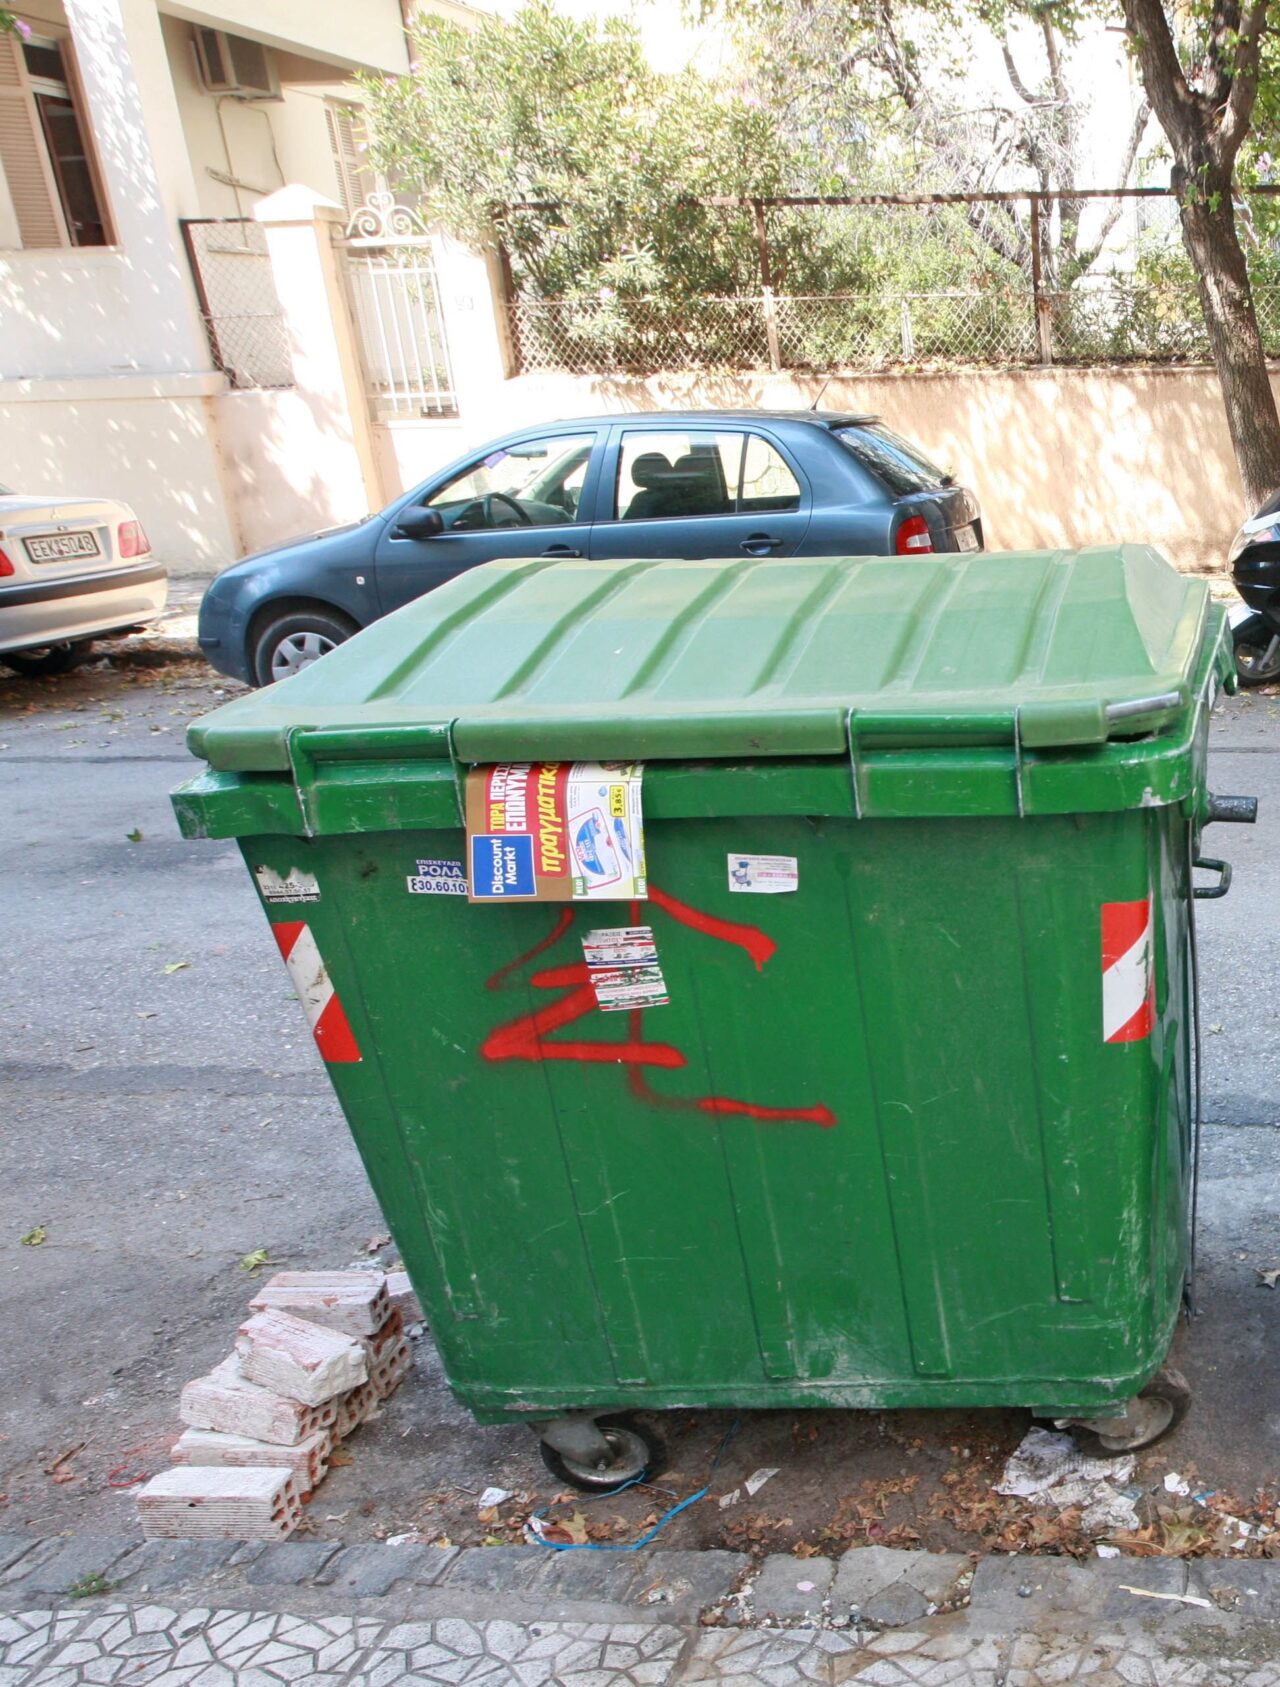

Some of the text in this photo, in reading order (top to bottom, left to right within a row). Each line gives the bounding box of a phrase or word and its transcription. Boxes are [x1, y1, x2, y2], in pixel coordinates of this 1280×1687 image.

[490, 802, 505, 831] ΤΩΡΑ
[418, 865, 463, 877] ΡΟΛΑ
[490, 838, 504, 894] Discount
[504, 846, 518, 885] Markt
